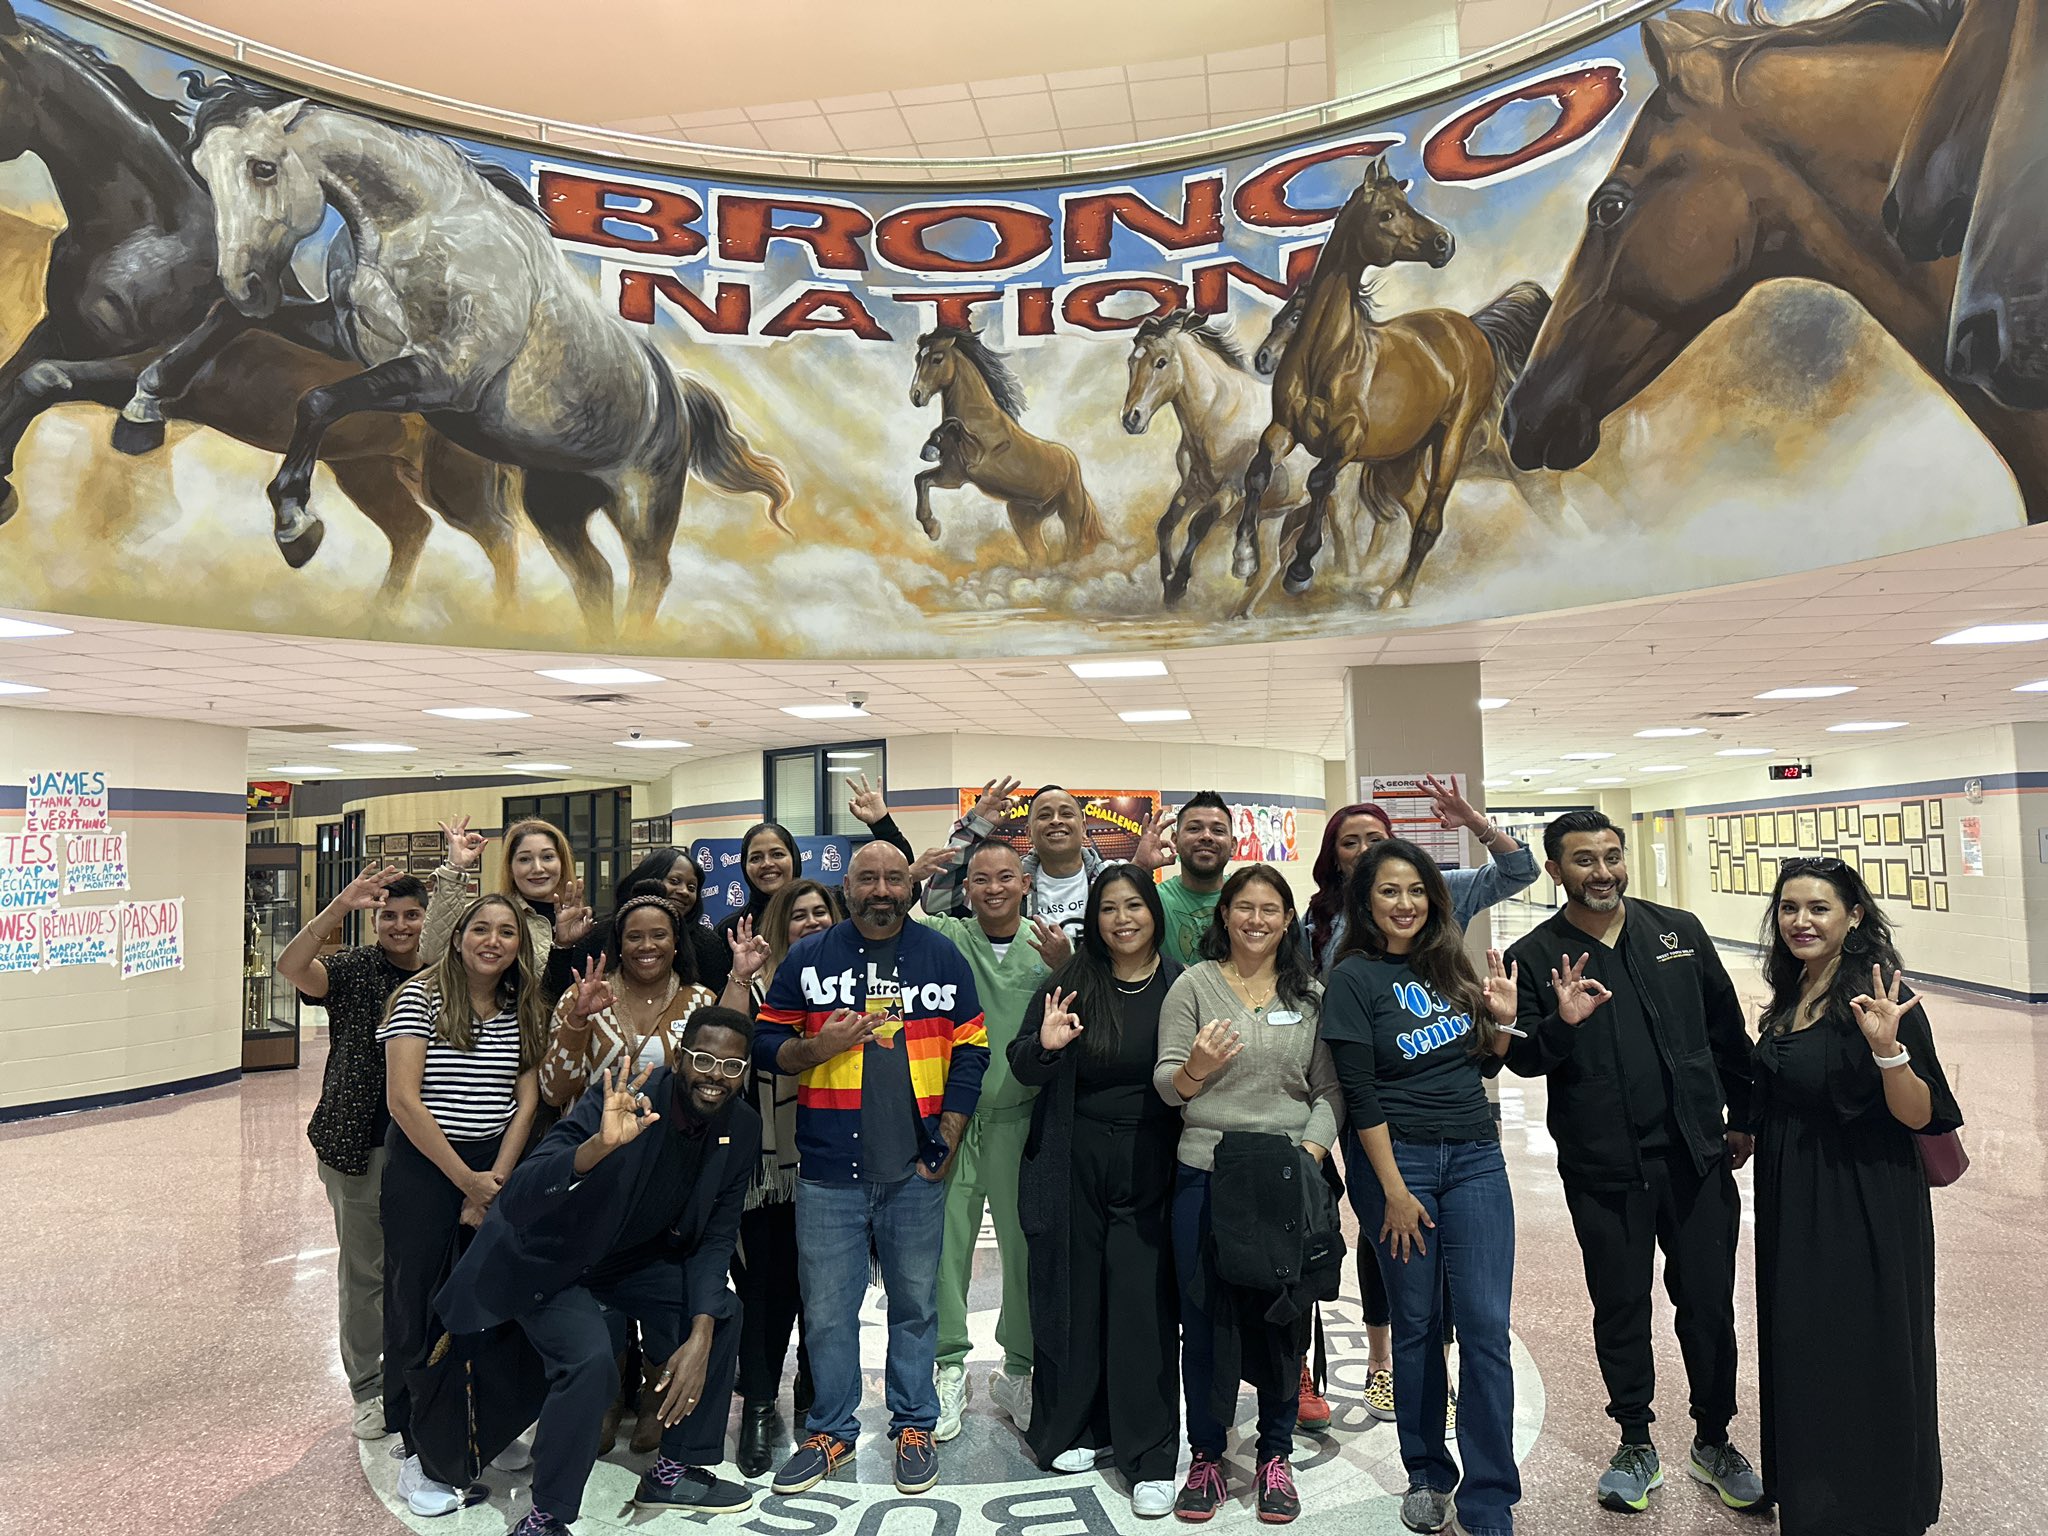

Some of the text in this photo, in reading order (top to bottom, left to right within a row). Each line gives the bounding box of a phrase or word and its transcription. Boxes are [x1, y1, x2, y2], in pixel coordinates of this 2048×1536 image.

[533, 60, 1625, 277] BRONCO
[612, 240, 1325, 343] NATION
[30, 772, 105, 796] JAMES
[29, 796, 101, 808] THANK YOU
[49, 809, 79, 818] FOR
[27, 818, 107, 831] EVERYTHING
[4, 834, 52, 864] TES
[23, 865, 43, 879] AP
[67, 863, 114, 875] HAPPY AP
[68, 872, 127, 883] APPRECIATION
[0, 879, 58, 892] ECIATION
[84, 881, 115, 890] MONTH
[1, 891, 47, 907] ONTH
[1038, 900, 1084, 915] LASS OF
[0, 912, 37, 942] NES
[43, 909, 117, 939] BENAVIDES
[123, 902, 178, 940] PARSAD
[16, 942, 33, 953] AP
[49, 941, 105, 953] HAPPY AP
[124, 938, 167, 955] HAPPY AP
[0, 952, 40, 962] RECIATION
[49, 951, 107, 960] APPRECIATION
[124, 945, 178, 963] APPRECIATION
[0, 961, 32, 971] ONTH
[136, 955, 174, 973] MONTH
[866, 982, 900, 996] stro
[738, 1484, 1128, 1536] BUS
